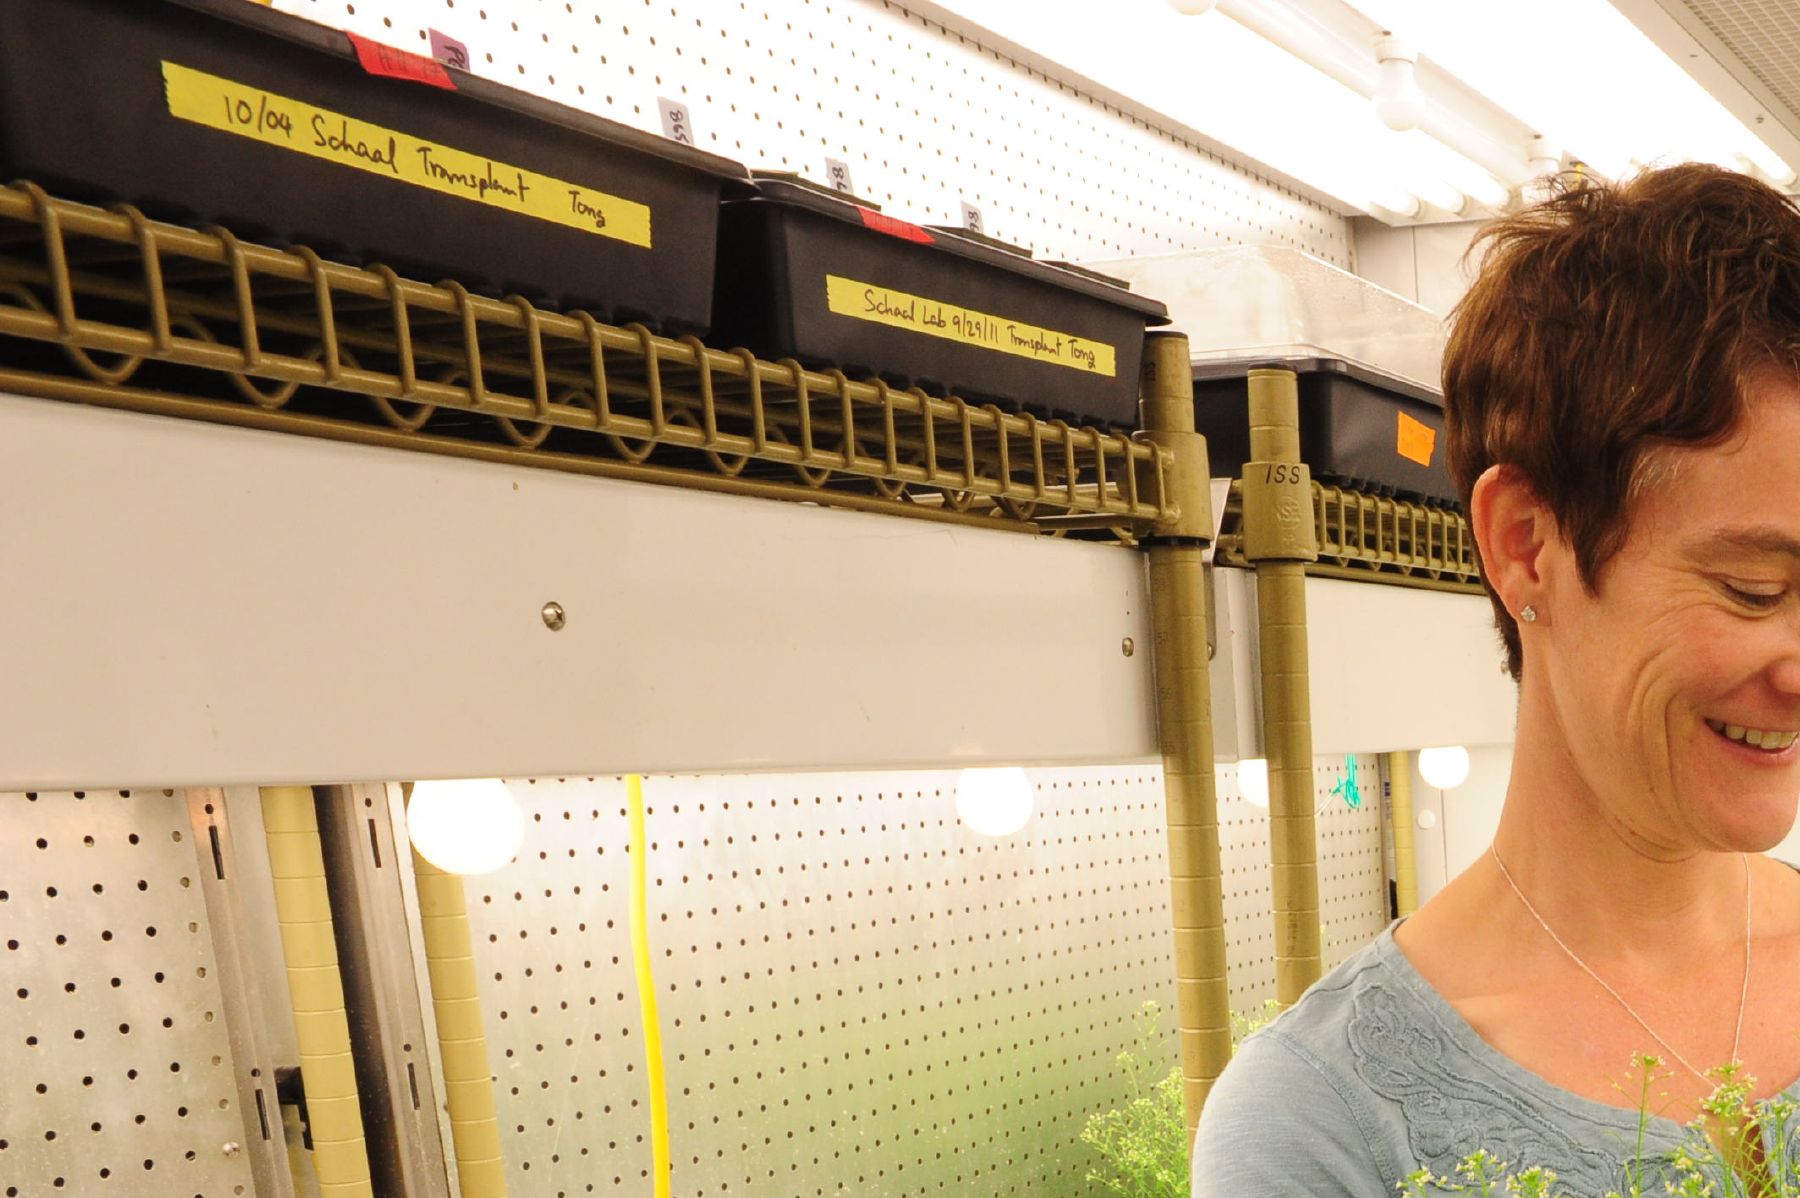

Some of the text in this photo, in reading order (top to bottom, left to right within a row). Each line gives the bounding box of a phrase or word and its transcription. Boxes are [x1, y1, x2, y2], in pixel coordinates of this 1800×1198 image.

[223, 94, 294, 139] 10/04
[567, 189, 607, 229] Tong
[922, 304, 947, 329] Lab
[951, 310, 1000, 345] 9/29/11
[1067, 337, 1097, 369] Tong
[1264, 464, 1301, 485] ISS
